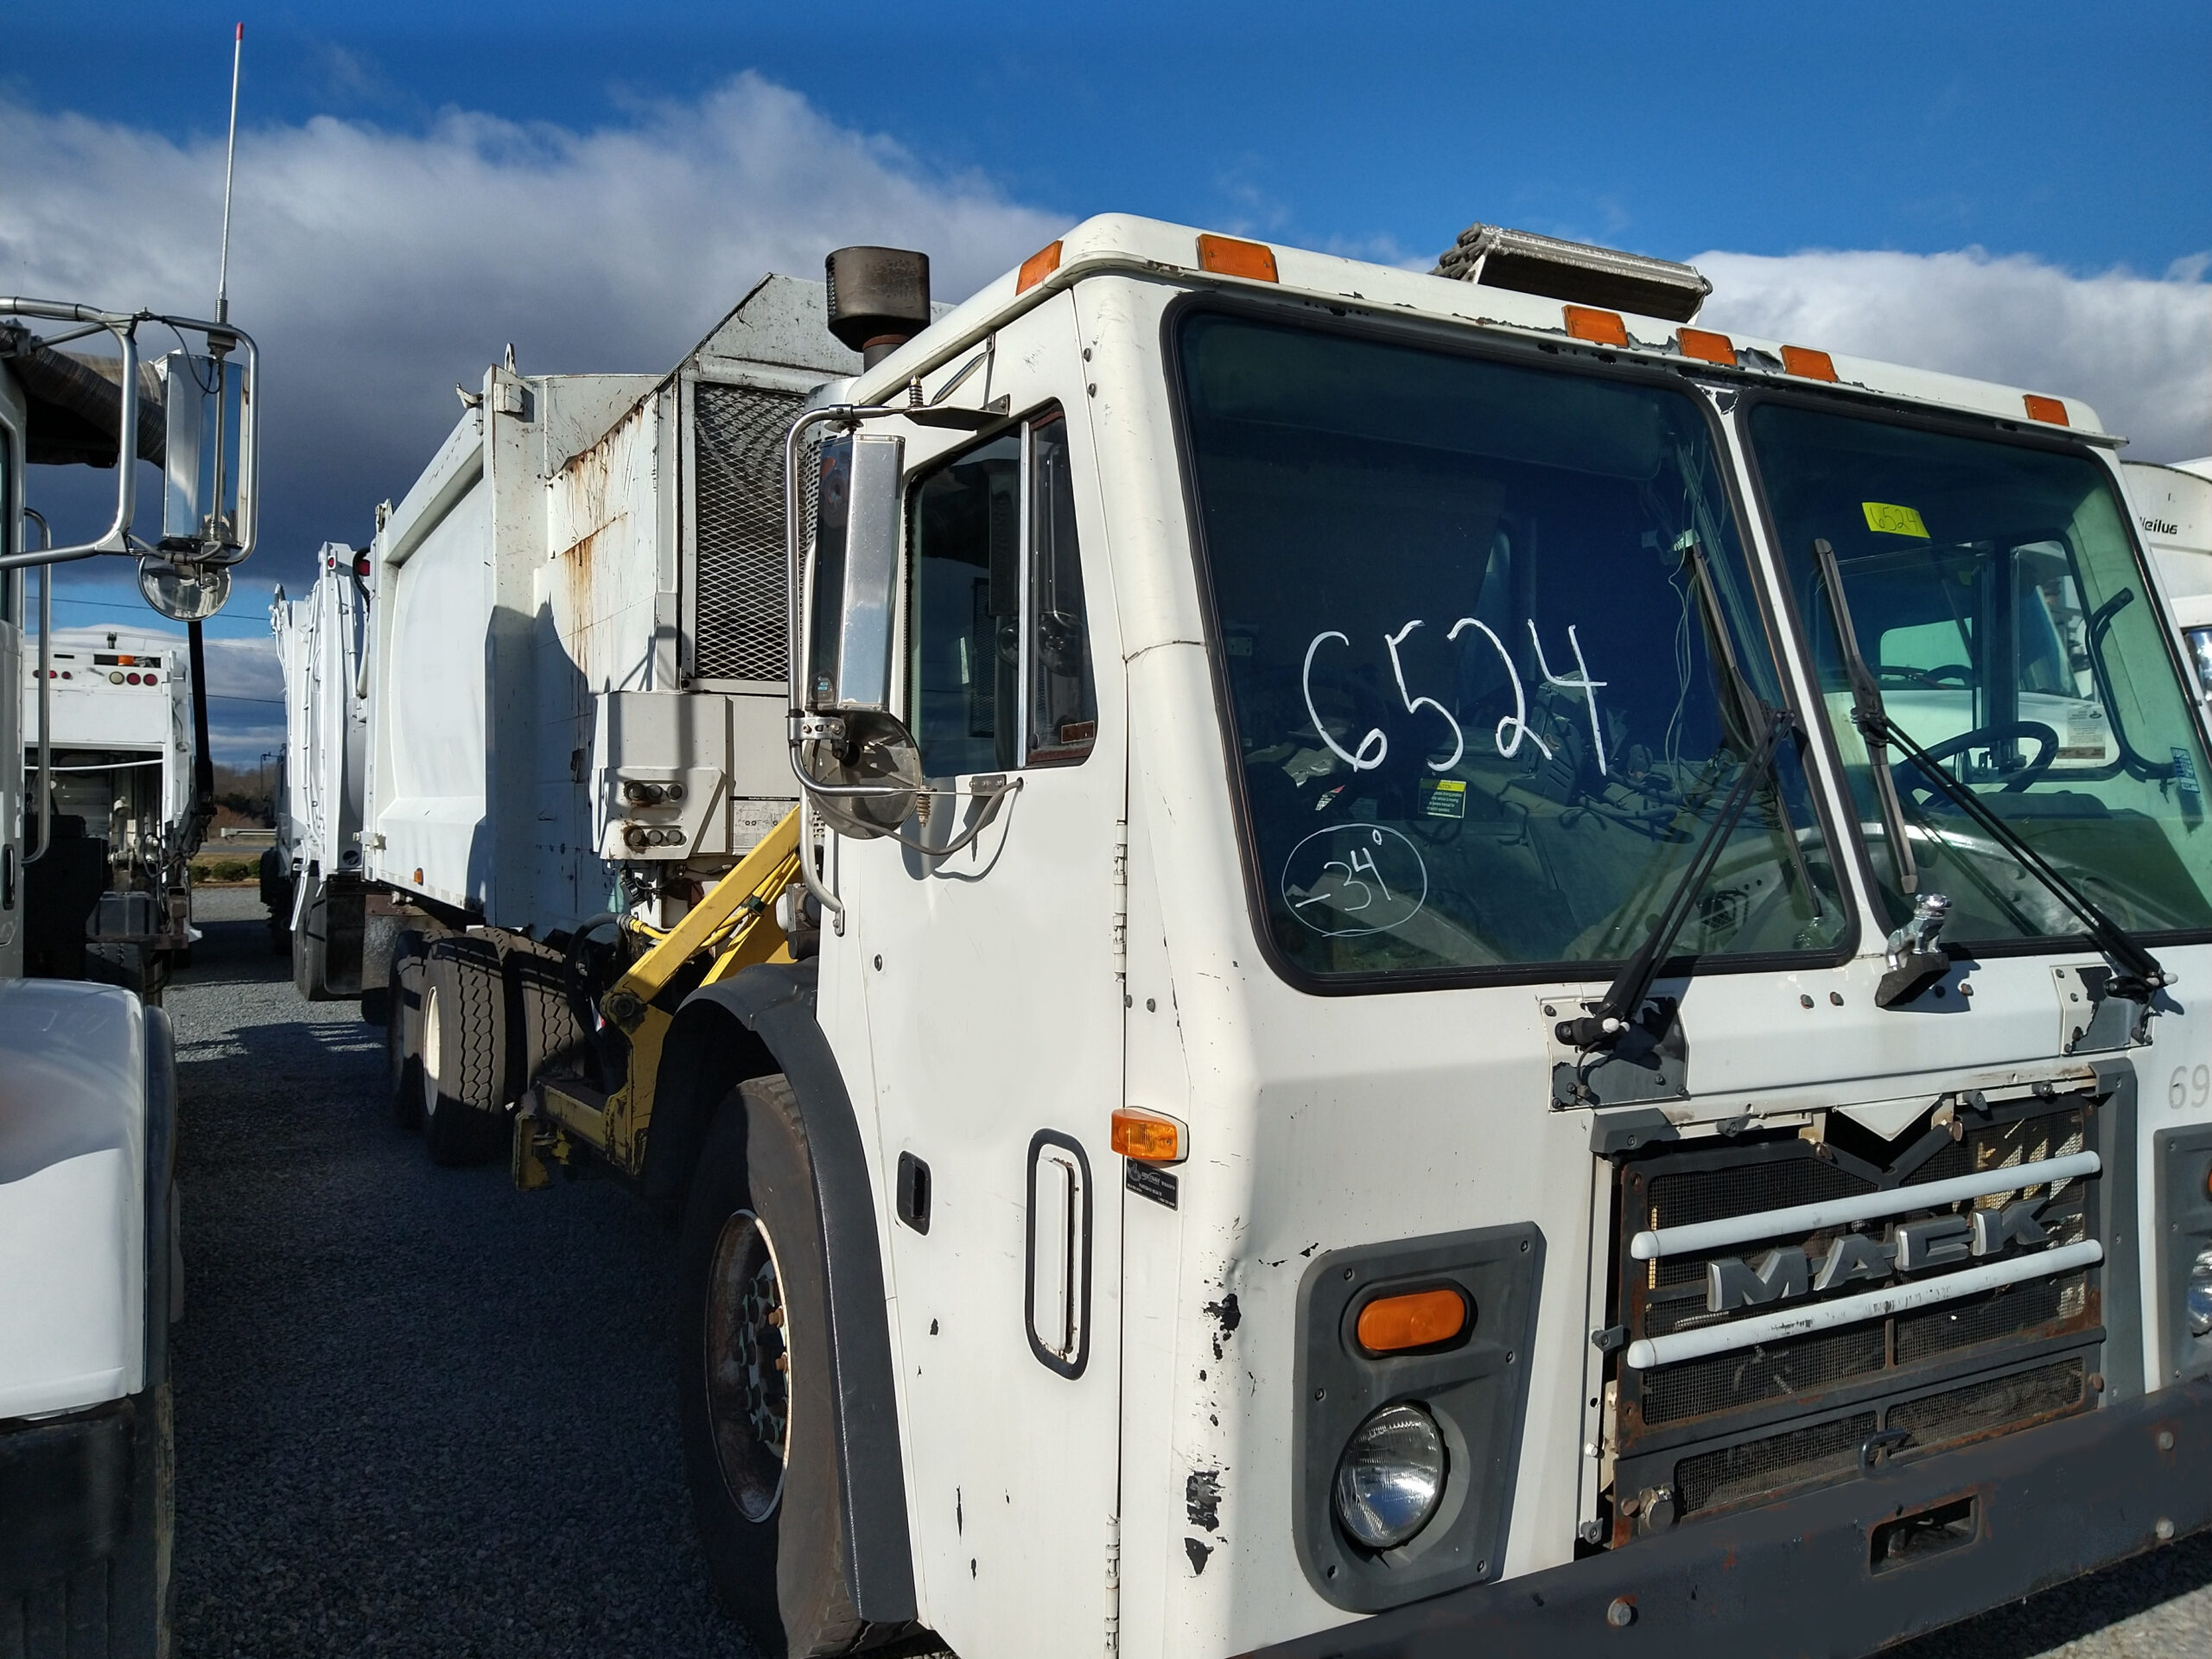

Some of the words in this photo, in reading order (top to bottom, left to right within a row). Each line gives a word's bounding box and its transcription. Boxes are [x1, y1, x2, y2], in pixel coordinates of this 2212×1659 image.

[1869, 506, 1919, 533] 6524
[2139, 516, 2178, 535] eilus
[1303, 617, 1608, 776] 6524
[2168, 1063, 2210, 1110] 69
[1707, 1197, 2050, 1313] MACK
